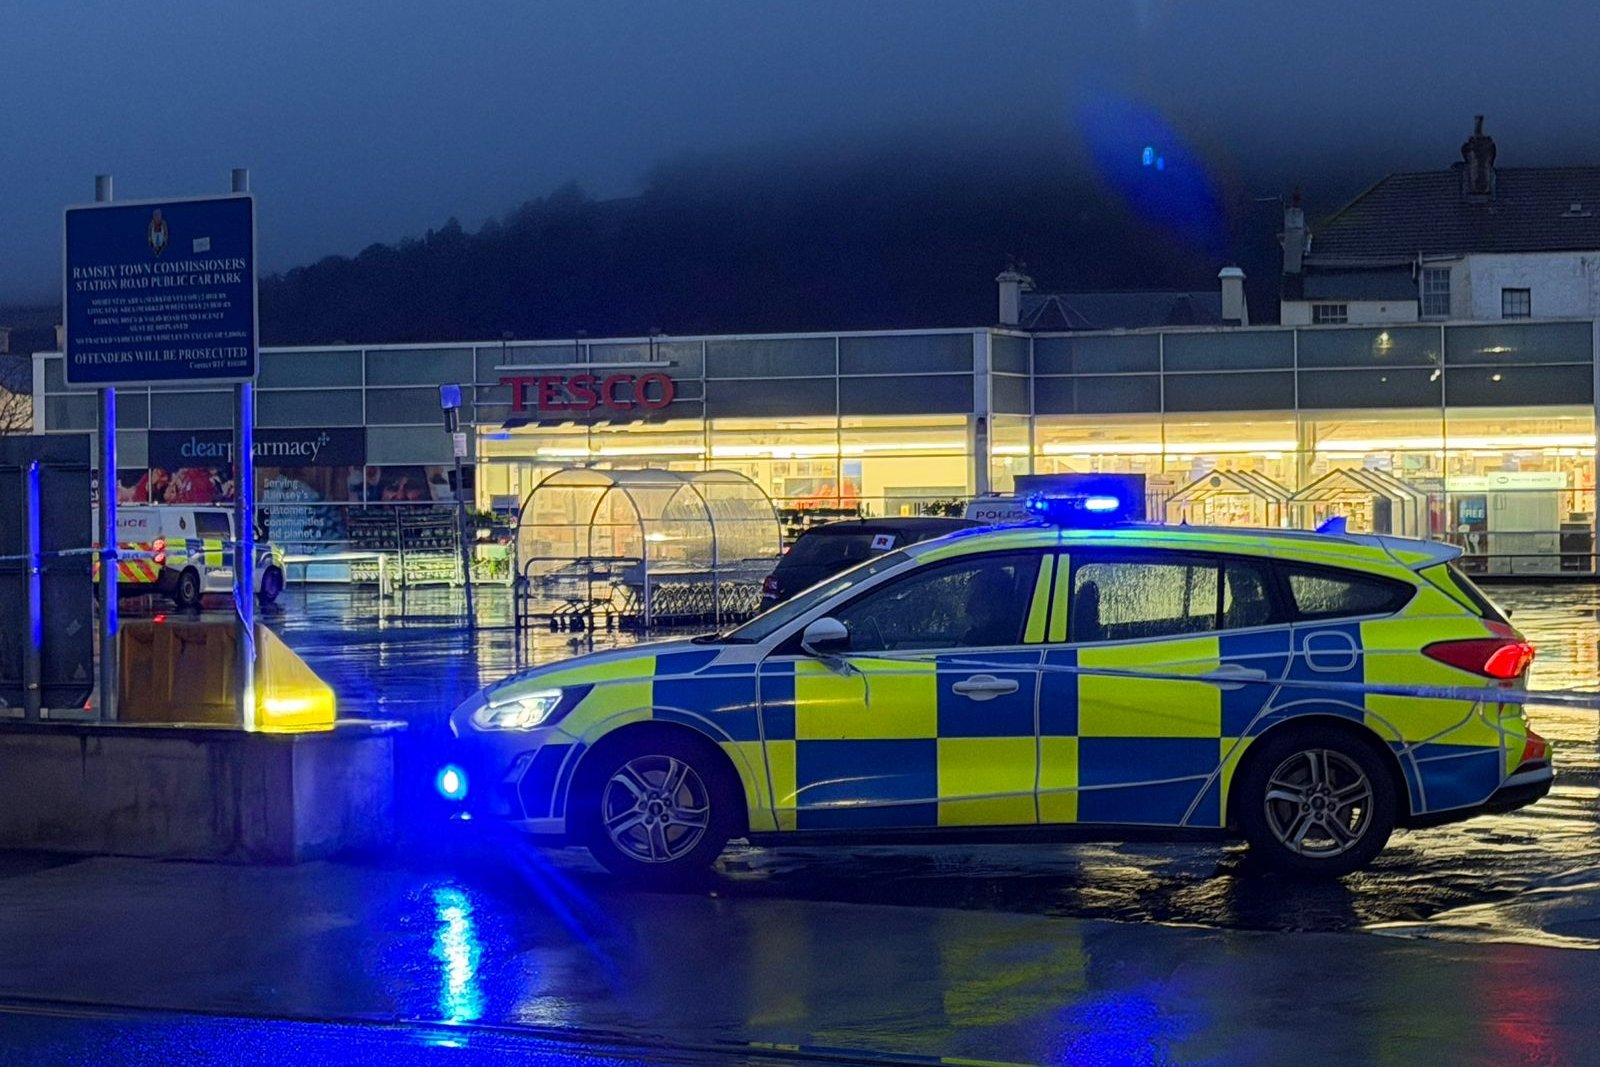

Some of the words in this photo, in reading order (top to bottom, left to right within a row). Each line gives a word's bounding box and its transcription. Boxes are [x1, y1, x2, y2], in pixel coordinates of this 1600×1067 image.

[73, 265, 117, 279] RAMSEY
[119, 263, 152, 276] TOWN
[153, 257, 246, 274] COMMISSIONERS
[76, 278, 118, 291] STATION
[120, 277, 149, 290] ROAD
[151, 275, 188, 288] PUBLIC
[189, 273, 212, 286] CAR
[214, 271, 242, 284] PARK
[74, 350, 134, 365] OFFENDERS
[135, 349, 161, 362] WILL
[163, 349, 177, 361] BE
[178, 347, 248, 361] PROSECUTED
[499, 373, 673, 412] TESCO
[263, 478, 298, 489] Serving
[116, 518, 147, 528] LICE
